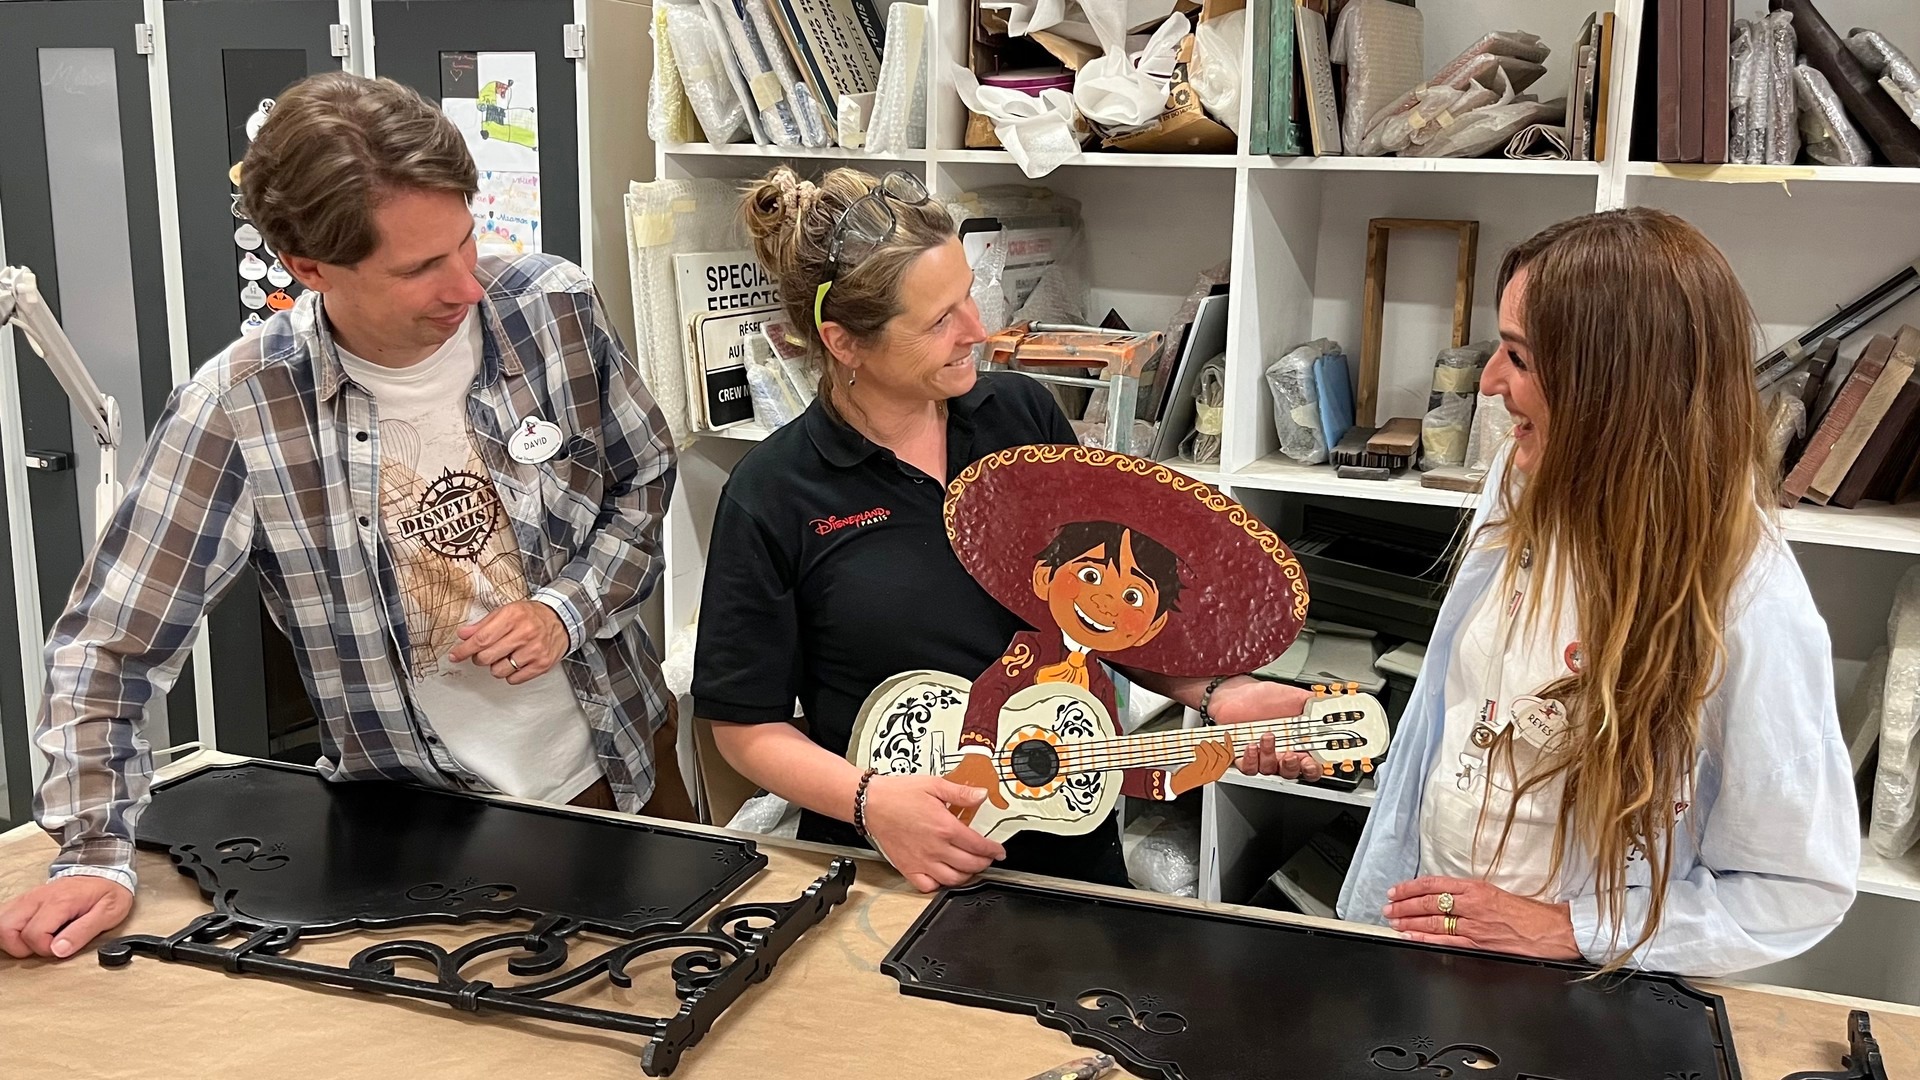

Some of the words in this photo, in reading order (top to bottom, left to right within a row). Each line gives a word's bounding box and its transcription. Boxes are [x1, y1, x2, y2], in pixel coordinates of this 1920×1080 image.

[836, 26, 849, 49] LES
[856, 1, 882, 56] SINGLE
[815, 18, 841, 73] GUESTS
[728, 345, 740, 359] AU
[718, 385, 742, 403] CREW
[524, 436, 548, 451] DAVID
[438, 510, 487, 541] PARIS
[861, 514, 888, 527] PARIS
[1528, 713, 1554, 737] REYES
